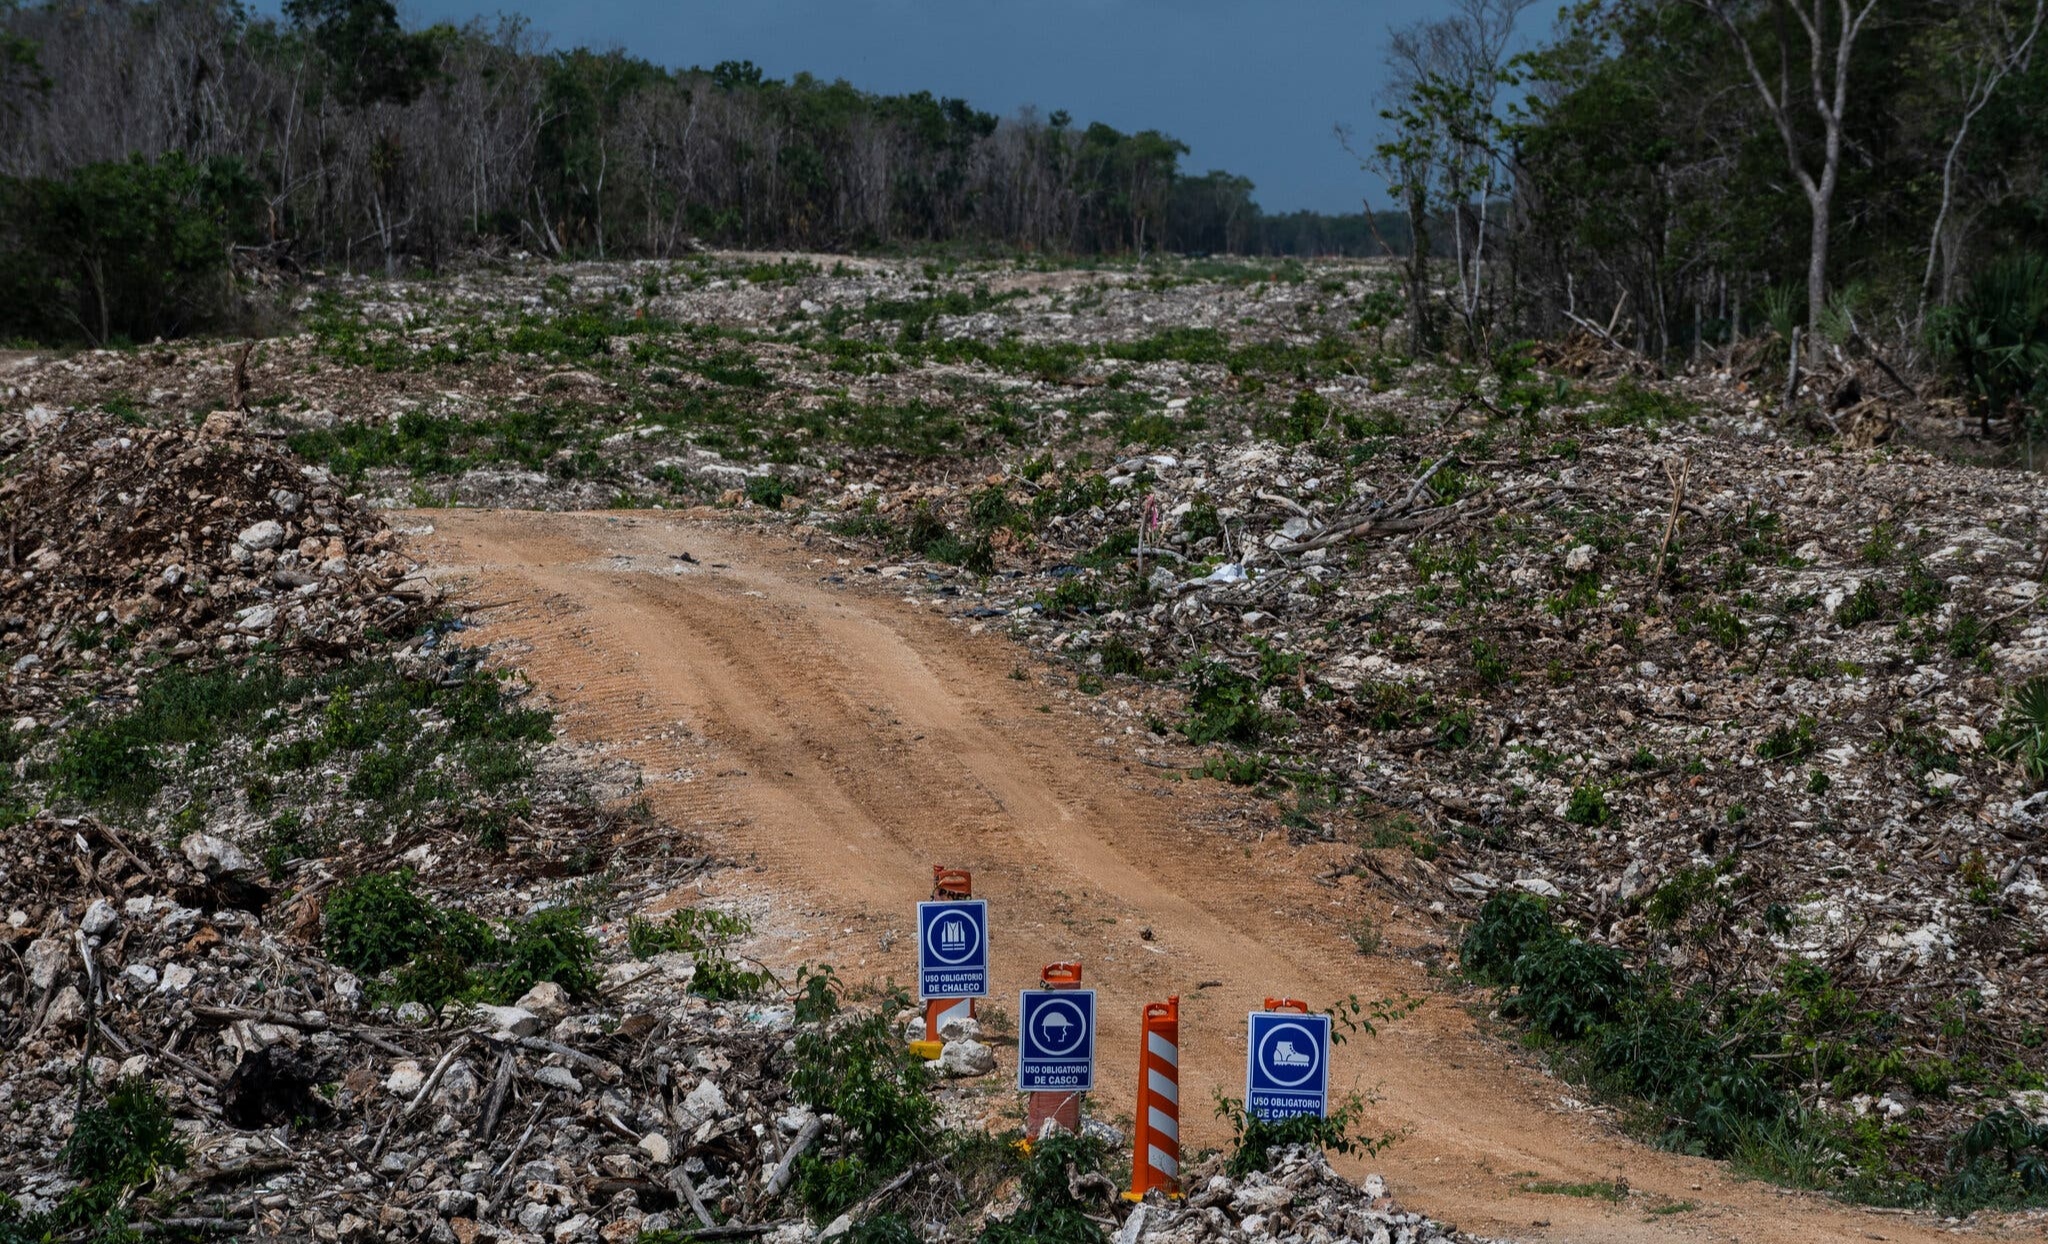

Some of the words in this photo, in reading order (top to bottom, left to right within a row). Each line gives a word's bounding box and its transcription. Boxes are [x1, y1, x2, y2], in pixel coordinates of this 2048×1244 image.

[940, 973, 982, 982] OBLIGATORIO
[929, 984, 940, 992] DE
[942, 982, 980, 992] CHALECO
[1025, 1066, 1040, 1074] USO
[1042, 1066, 1088, 1074] OBLIGATORIO
[1034, 1076, 1046, 1084] DE
[1048, 1076, 1078, 1084] CASCO
[1254, 1096, 1269, 1106] USO
[1270, 1098, 1320, 1108] OBLIGATORIO
[1257, 1108, 1270, 1118] DE
